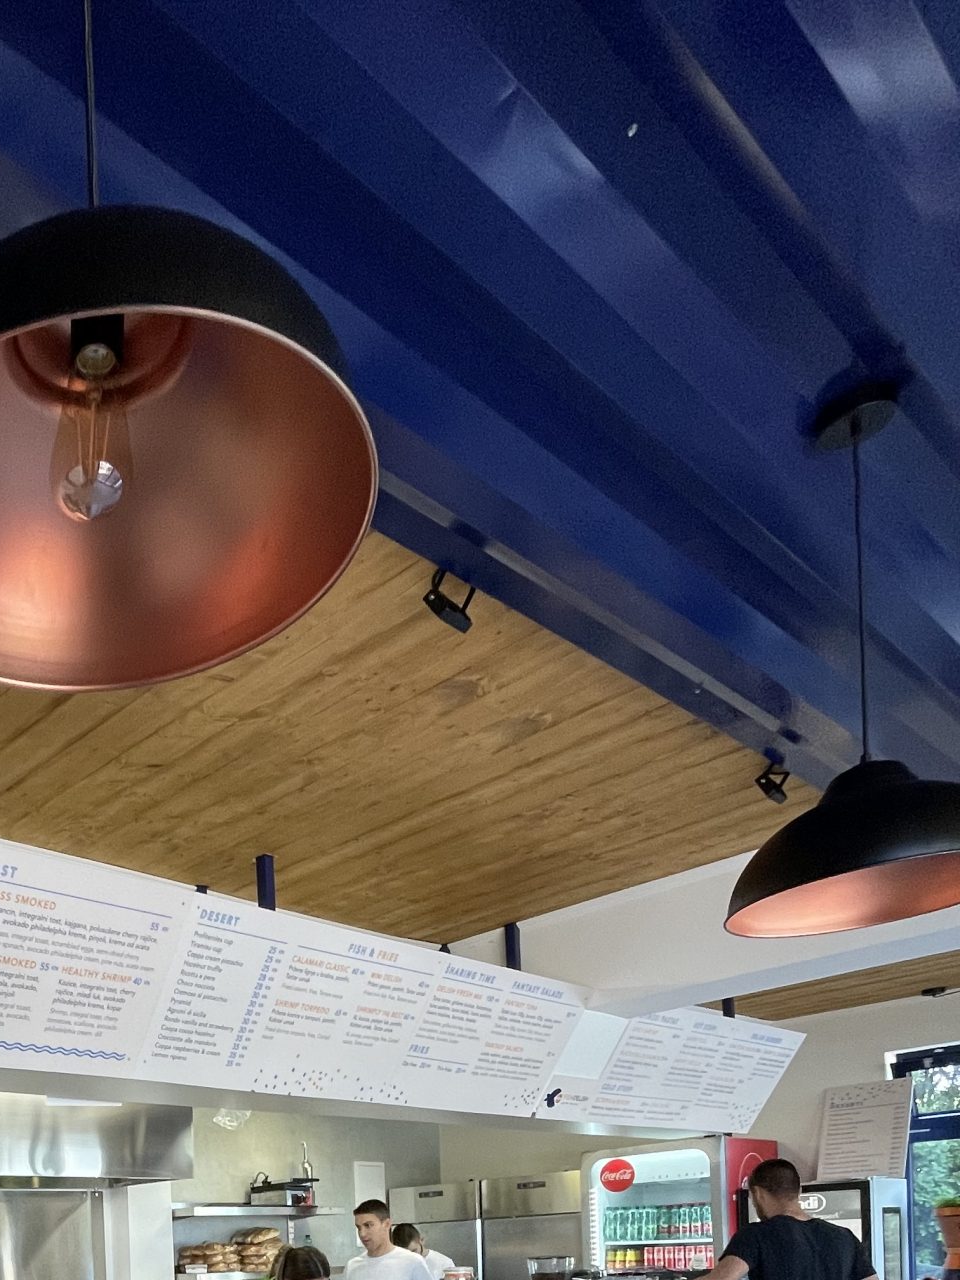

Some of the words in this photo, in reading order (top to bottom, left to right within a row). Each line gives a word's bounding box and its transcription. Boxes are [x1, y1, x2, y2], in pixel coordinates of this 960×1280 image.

[14, 894, 56, 910] SMOKED
[200, 909, 240, 927] DESERT
[150, 922, 159, 931] 55
[348, 943, 367, 955] FISH
[377, 950, 399, 962] FRIES
[39, 962, 50, 971] 55
[61, 966, 99, 978] HEALTHY
[100, 971, 132, 983] SHRIMP
[445, 964, 477, 980] SHARING
[479, 973, 496, 984] TIME
[512, 981, 541, 994] FANTASY
[408, 1044, 430, 1054] FRIES
[602, 1169, 632, 1181] Coca-Cola
